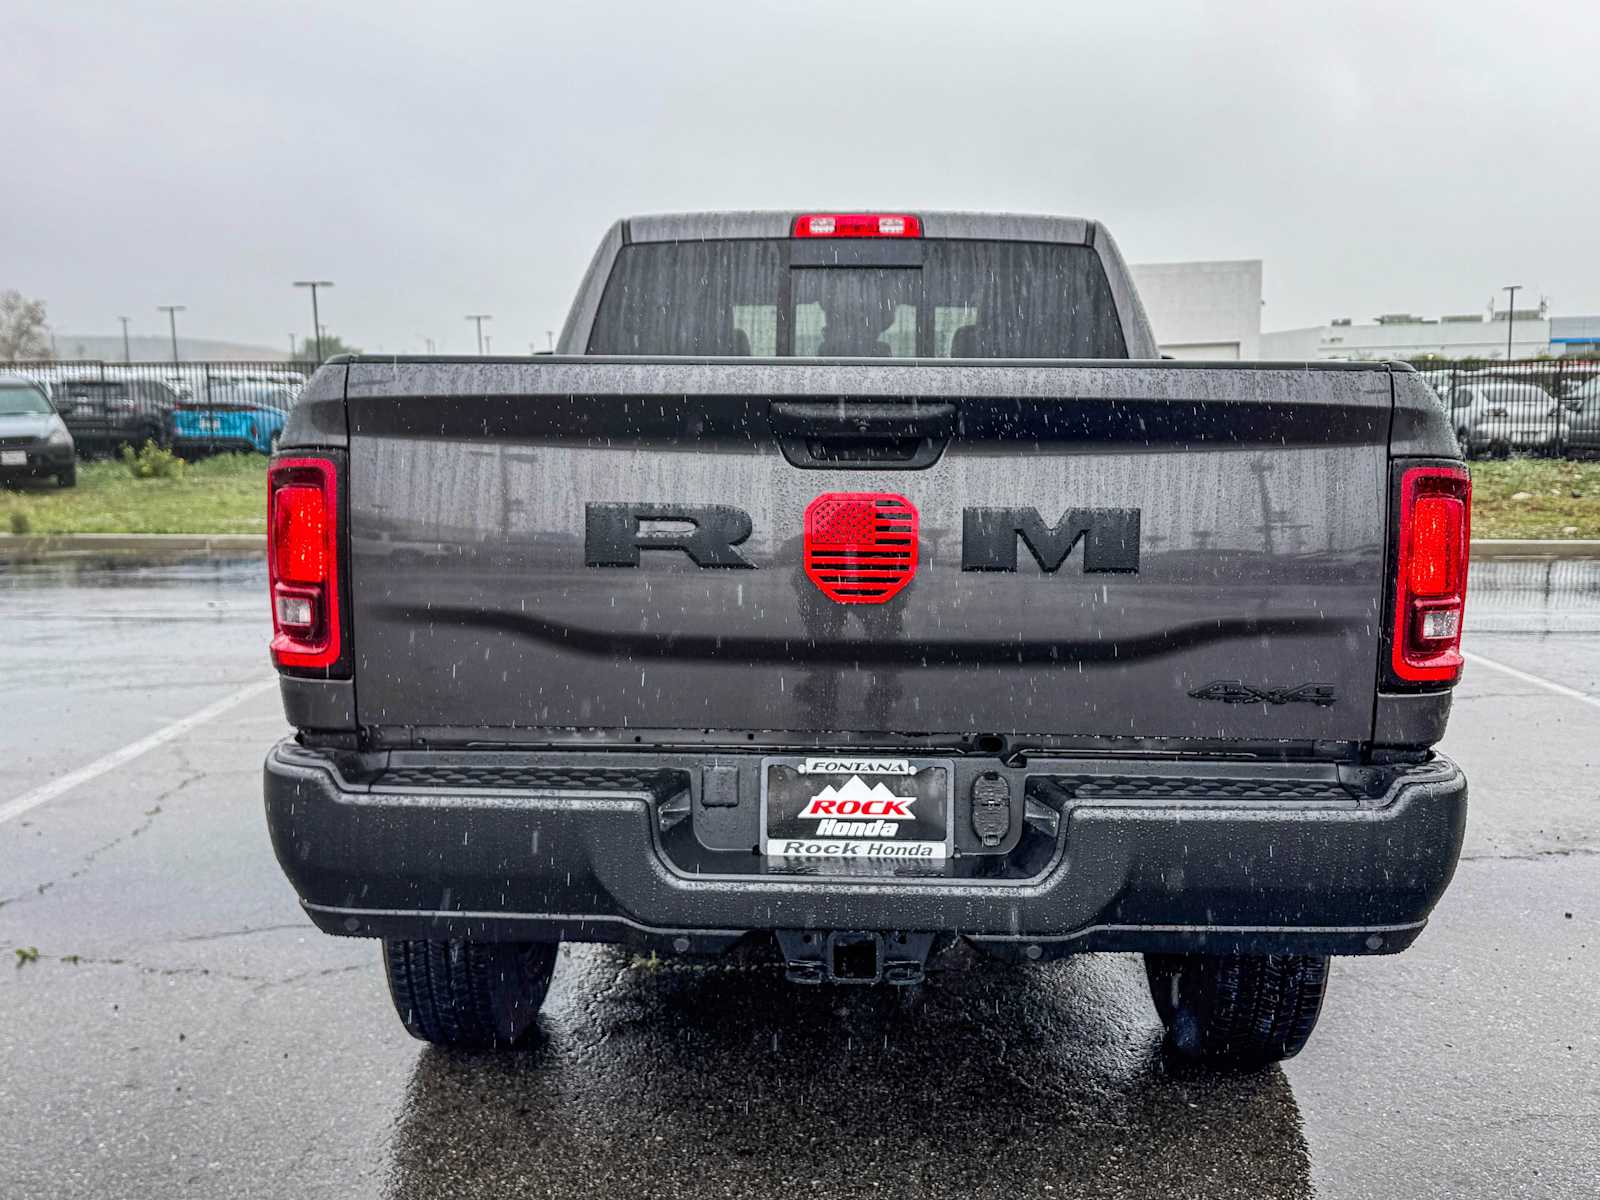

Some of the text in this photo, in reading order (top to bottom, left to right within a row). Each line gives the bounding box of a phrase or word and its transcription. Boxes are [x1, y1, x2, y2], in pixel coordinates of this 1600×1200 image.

[812, 761, 906, 772] FONTANA
[810, 800, 907, 815] ROCK
[816, 818, 899, 837] Honda
[783, 841, 933, 857] Rock Honda
